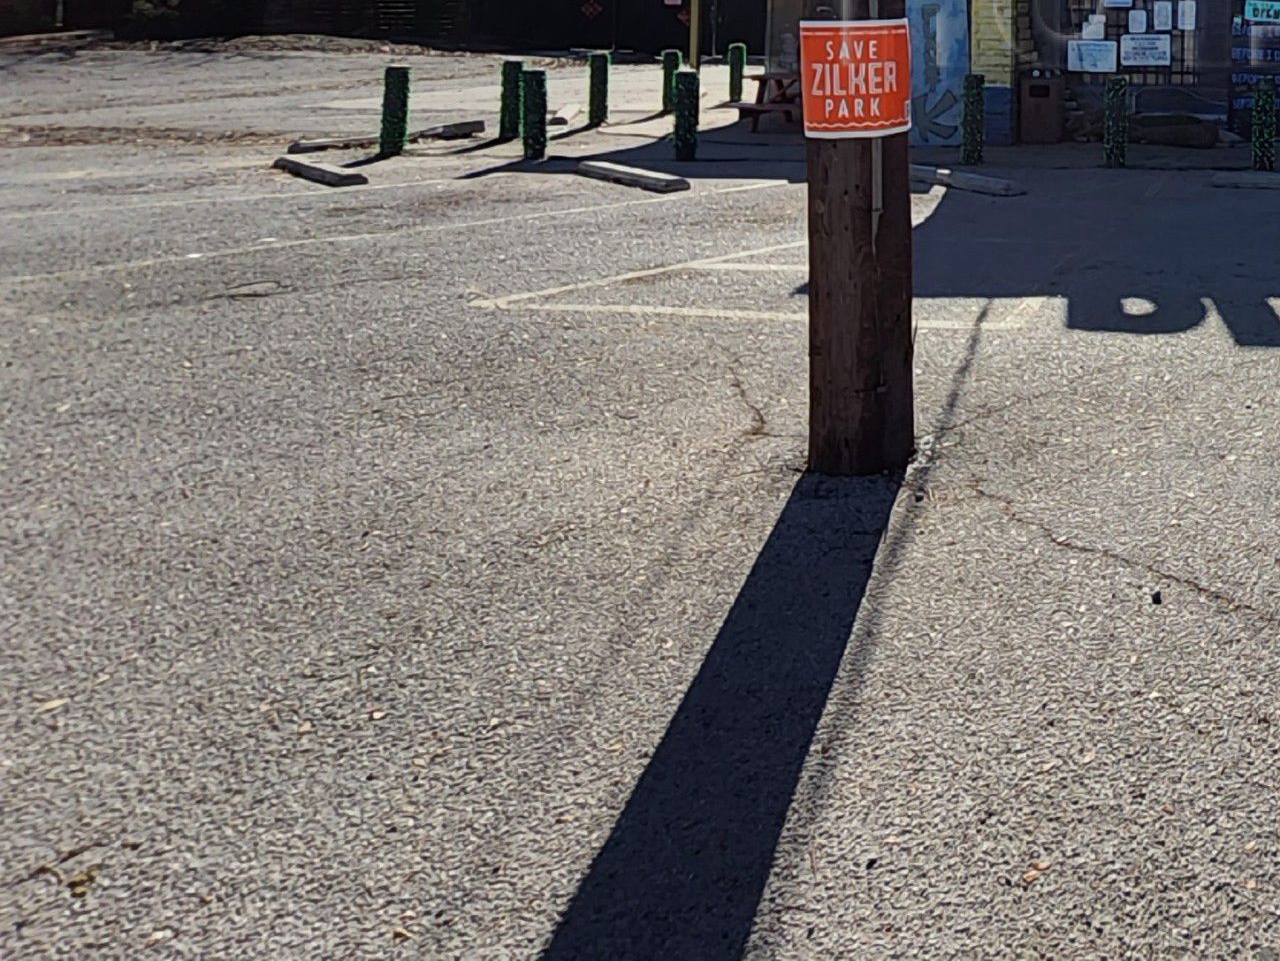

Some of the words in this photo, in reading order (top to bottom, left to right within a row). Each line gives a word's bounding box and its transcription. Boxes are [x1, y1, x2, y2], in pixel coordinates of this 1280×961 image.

[825, 40, 878, 60] SAVE
[811, 61, 897, 96] ZILKER
[825, 96, 880, 119] PARK
